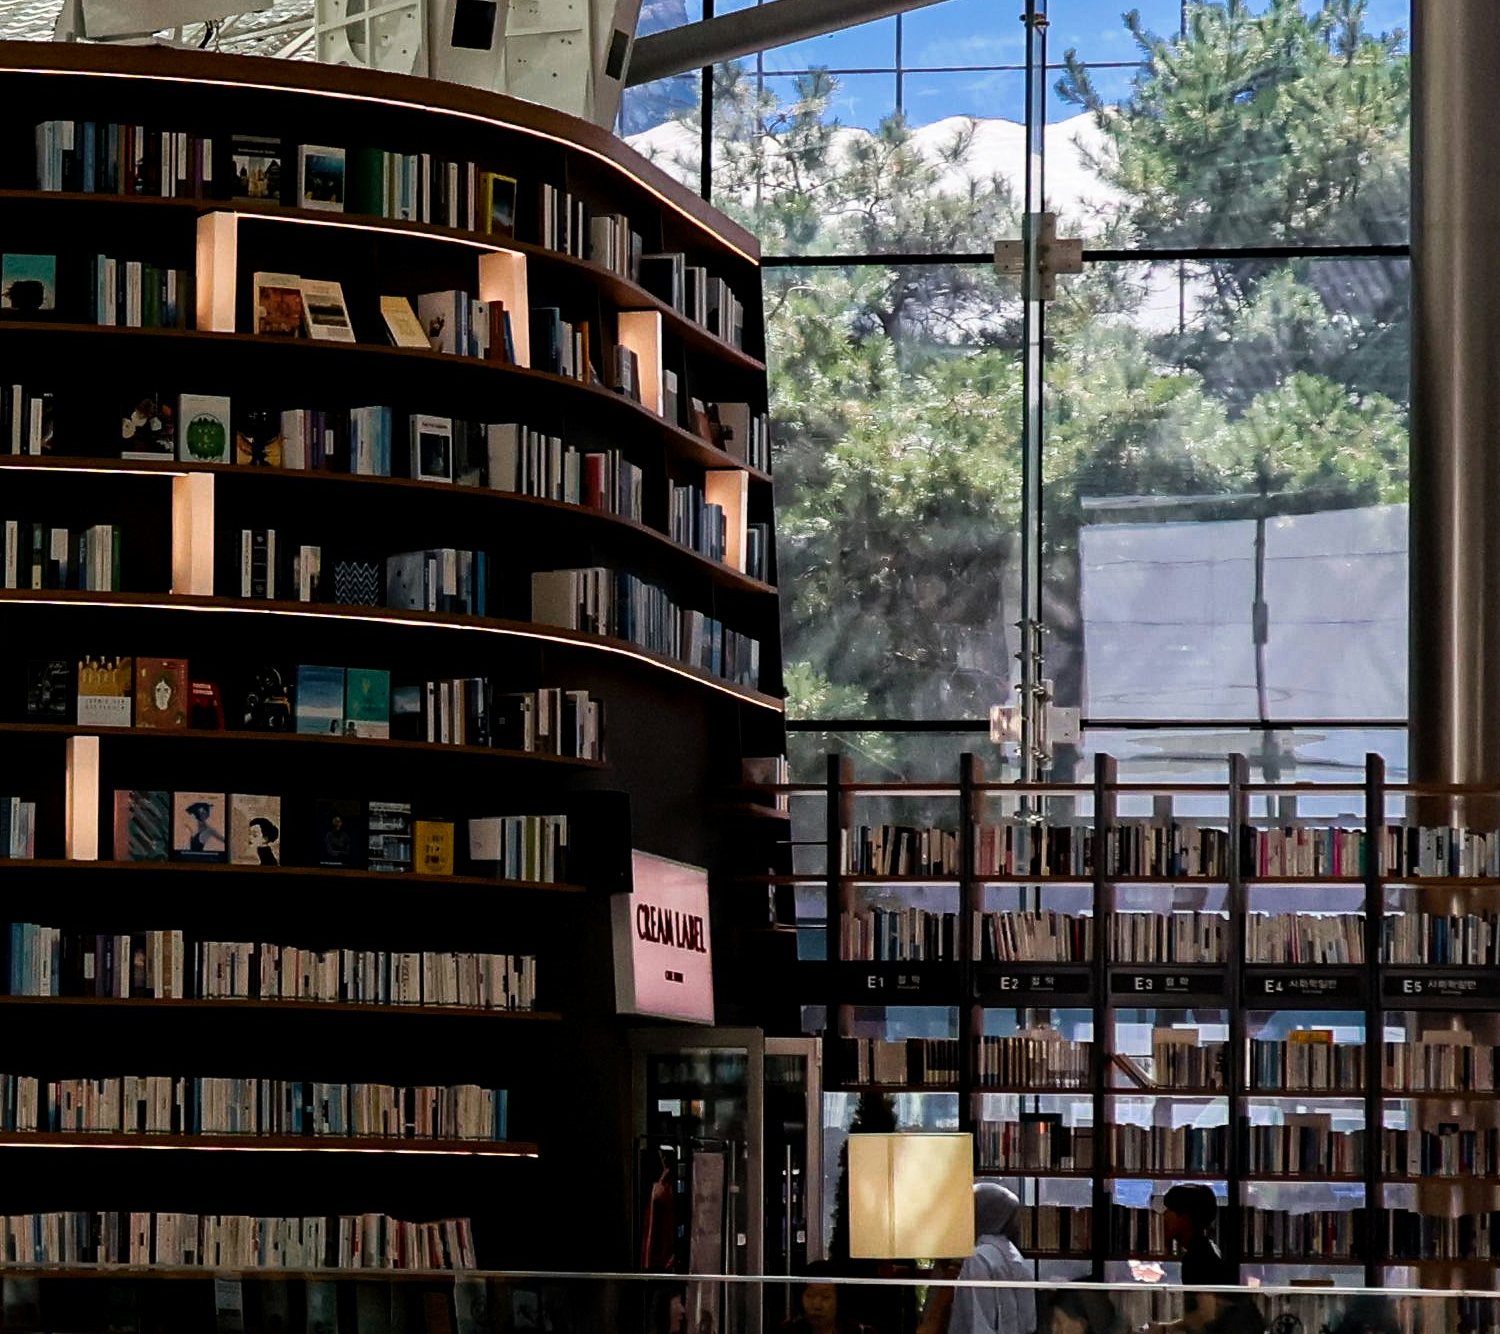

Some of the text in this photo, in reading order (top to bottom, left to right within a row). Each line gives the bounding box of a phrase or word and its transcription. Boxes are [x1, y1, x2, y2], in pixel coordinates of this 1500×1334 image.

[637, 904, 707, 954] CREAM LABEL
[867, 975, 885, 989] E1
[1000, 976, 1020, 990] E2
[1134, 977, 1154, 990] E3
[1264, 979, 1284, 994] E4
[1403, 979, 1423, 994] E5
